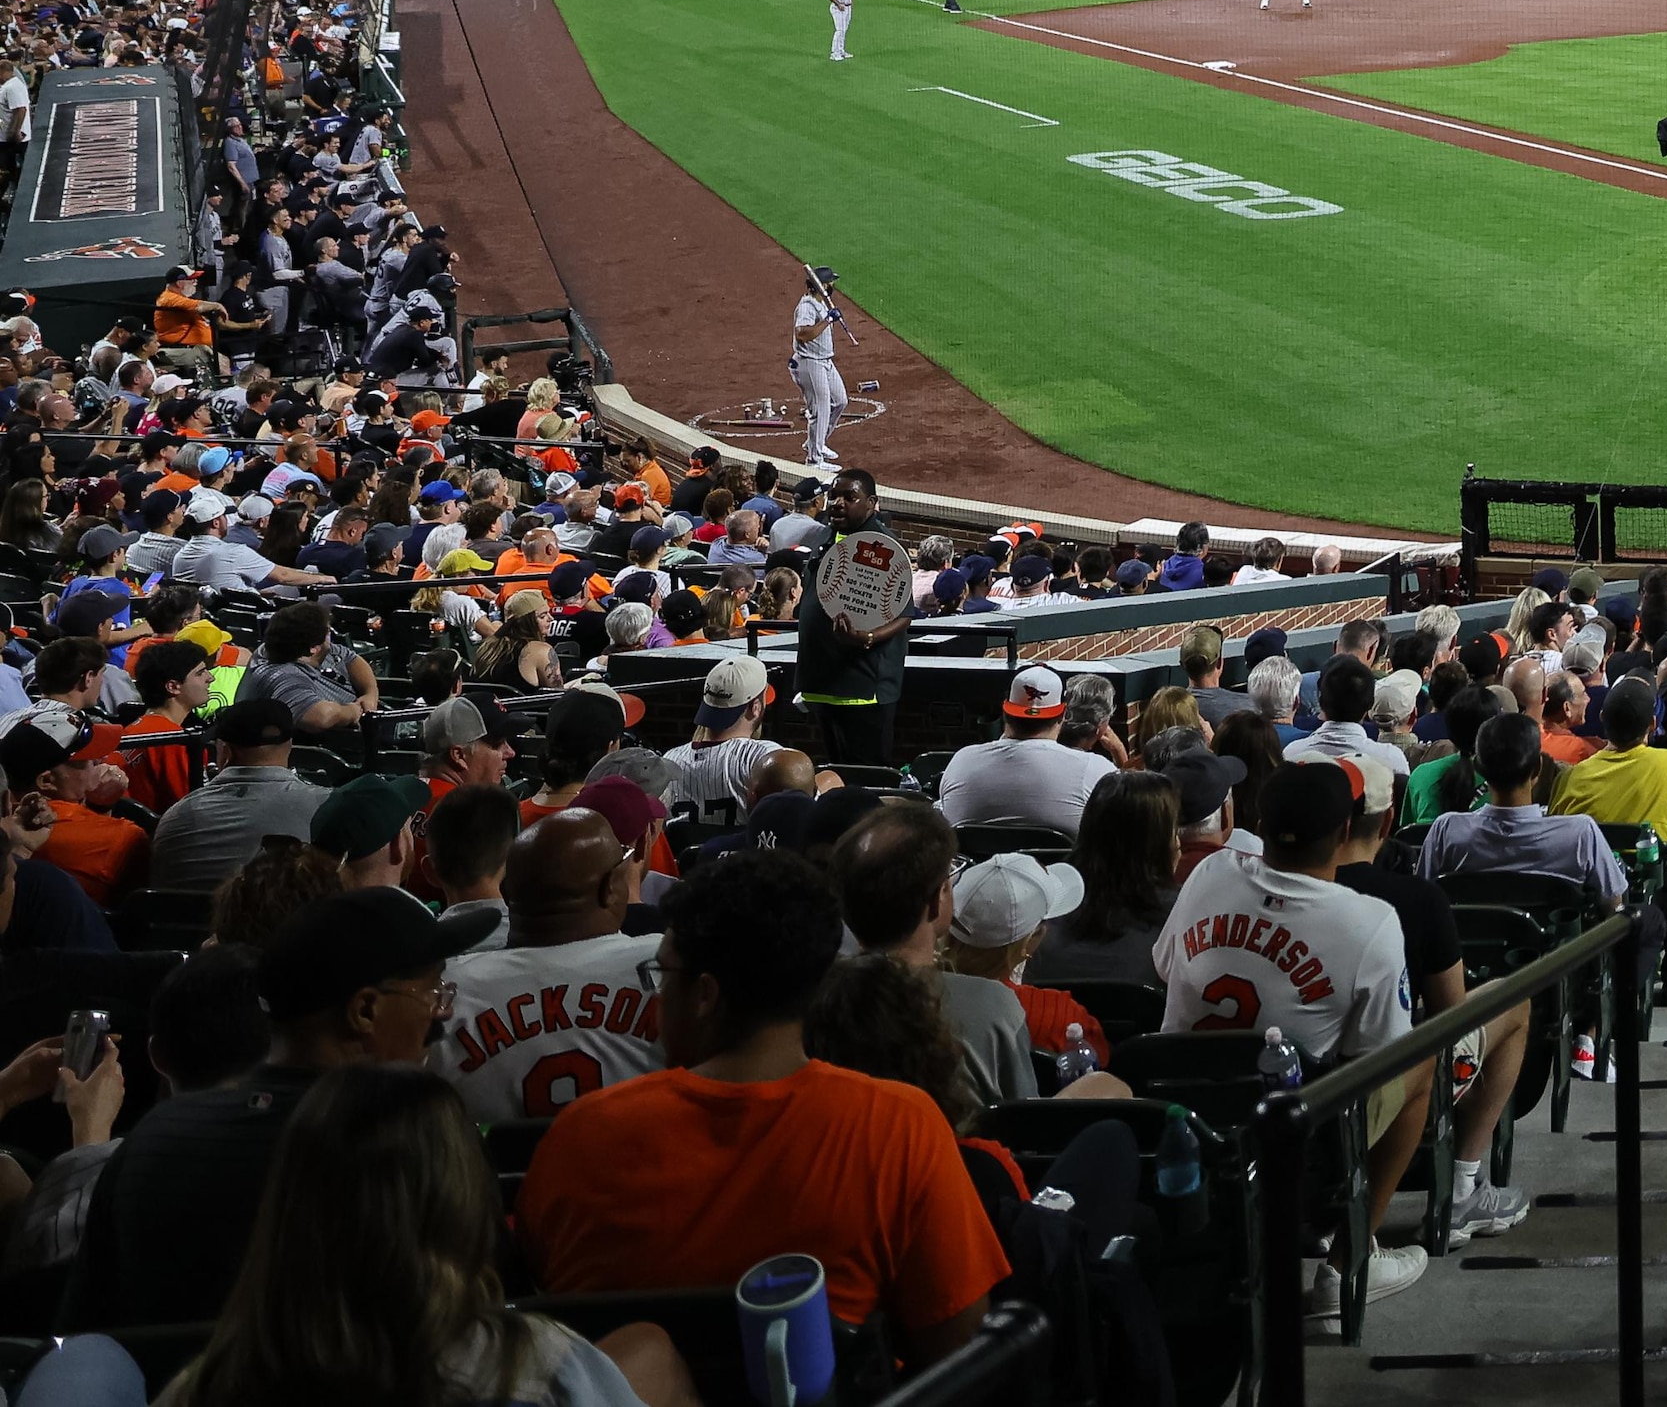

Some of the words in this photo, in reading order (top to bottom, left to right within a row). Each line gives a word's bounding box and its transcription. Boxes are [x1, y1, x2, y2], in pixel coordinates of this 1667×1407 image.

[1065, 149, 1345, 220] GEICO
[822, 558, 835, 585] CREDIT
[1182, 913, 1335, 1006] HENDERSON
[457, 983, 661, 1073] JACKSON
[1194, 973, 1261, 1030] 2
